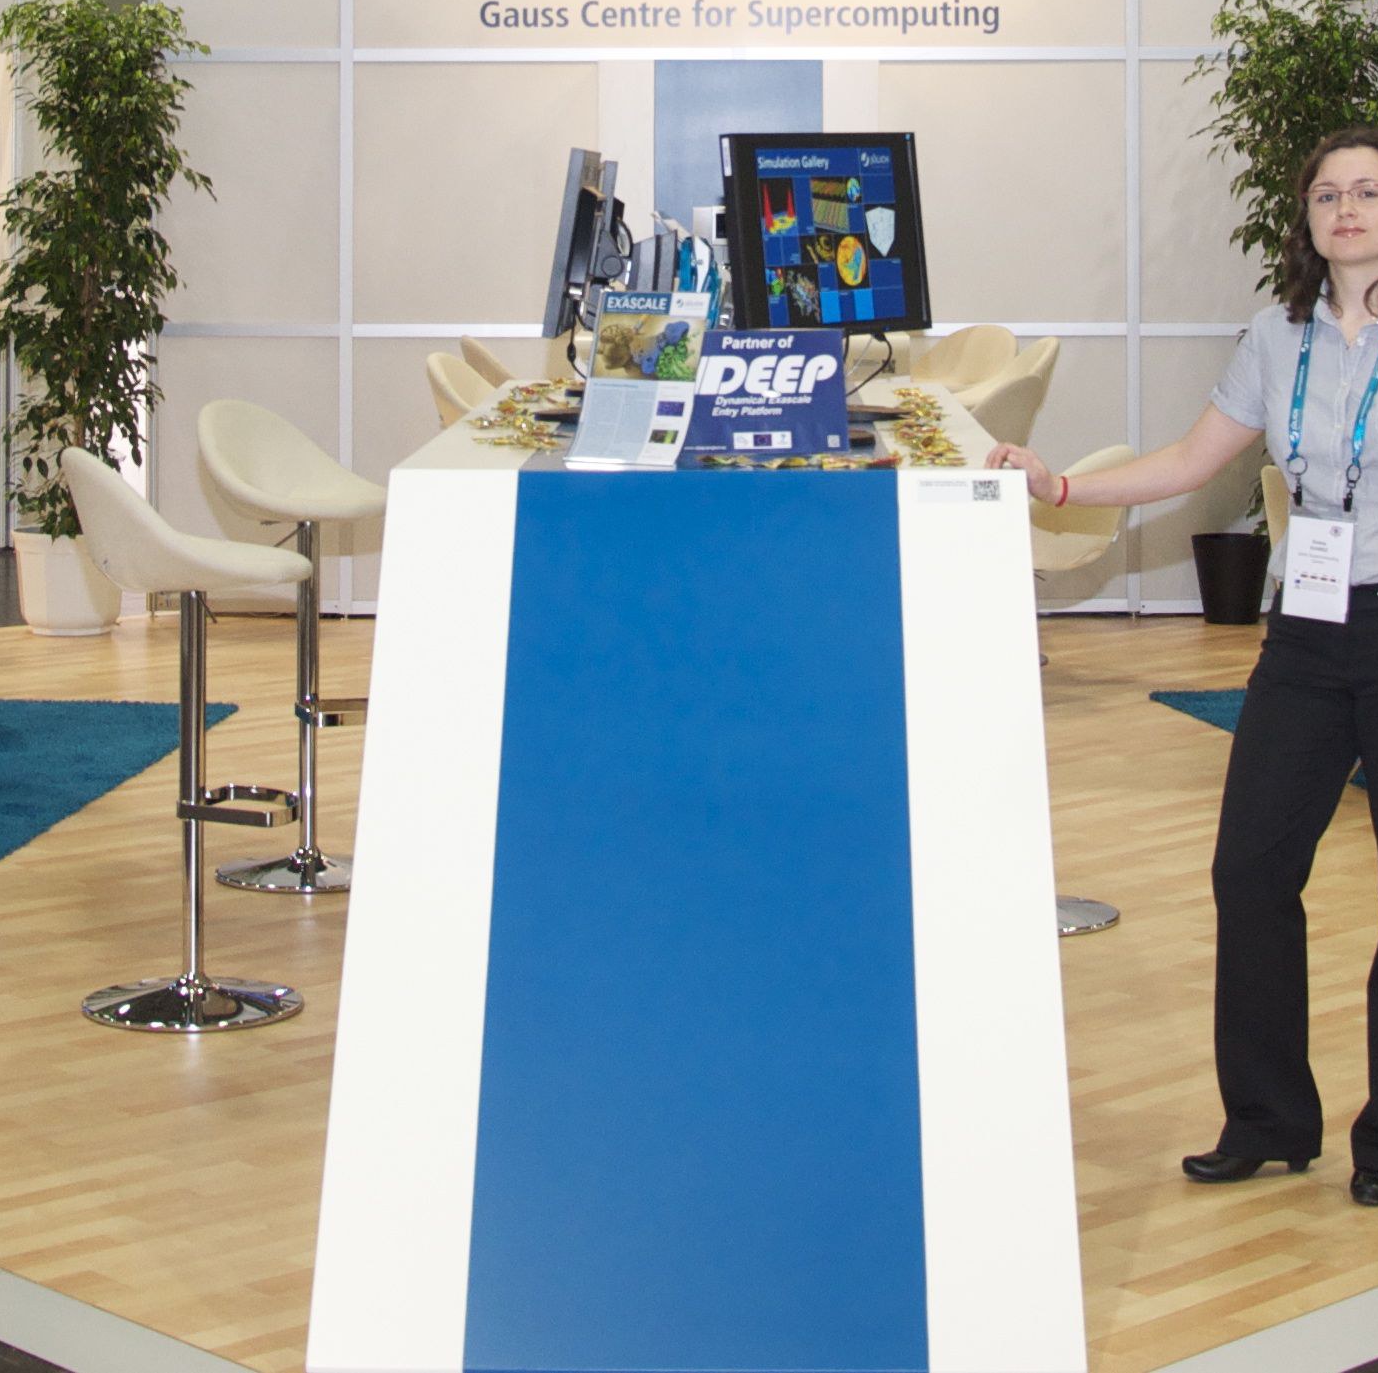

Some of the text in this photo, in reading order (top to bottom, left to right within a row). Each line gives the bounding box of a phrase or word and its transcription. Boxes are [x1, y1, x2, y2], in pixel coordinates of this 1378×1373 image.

[479, 1, 570, 29] Gauss
[580, 1, 682, 29] Centre
[757, 155, 830, 171] Simulation Gallery
[606, 295, 668, 311] EXASCALE
[722, 335, 795, 350] Partner of
[695, 354, 838, 396] DEEP
